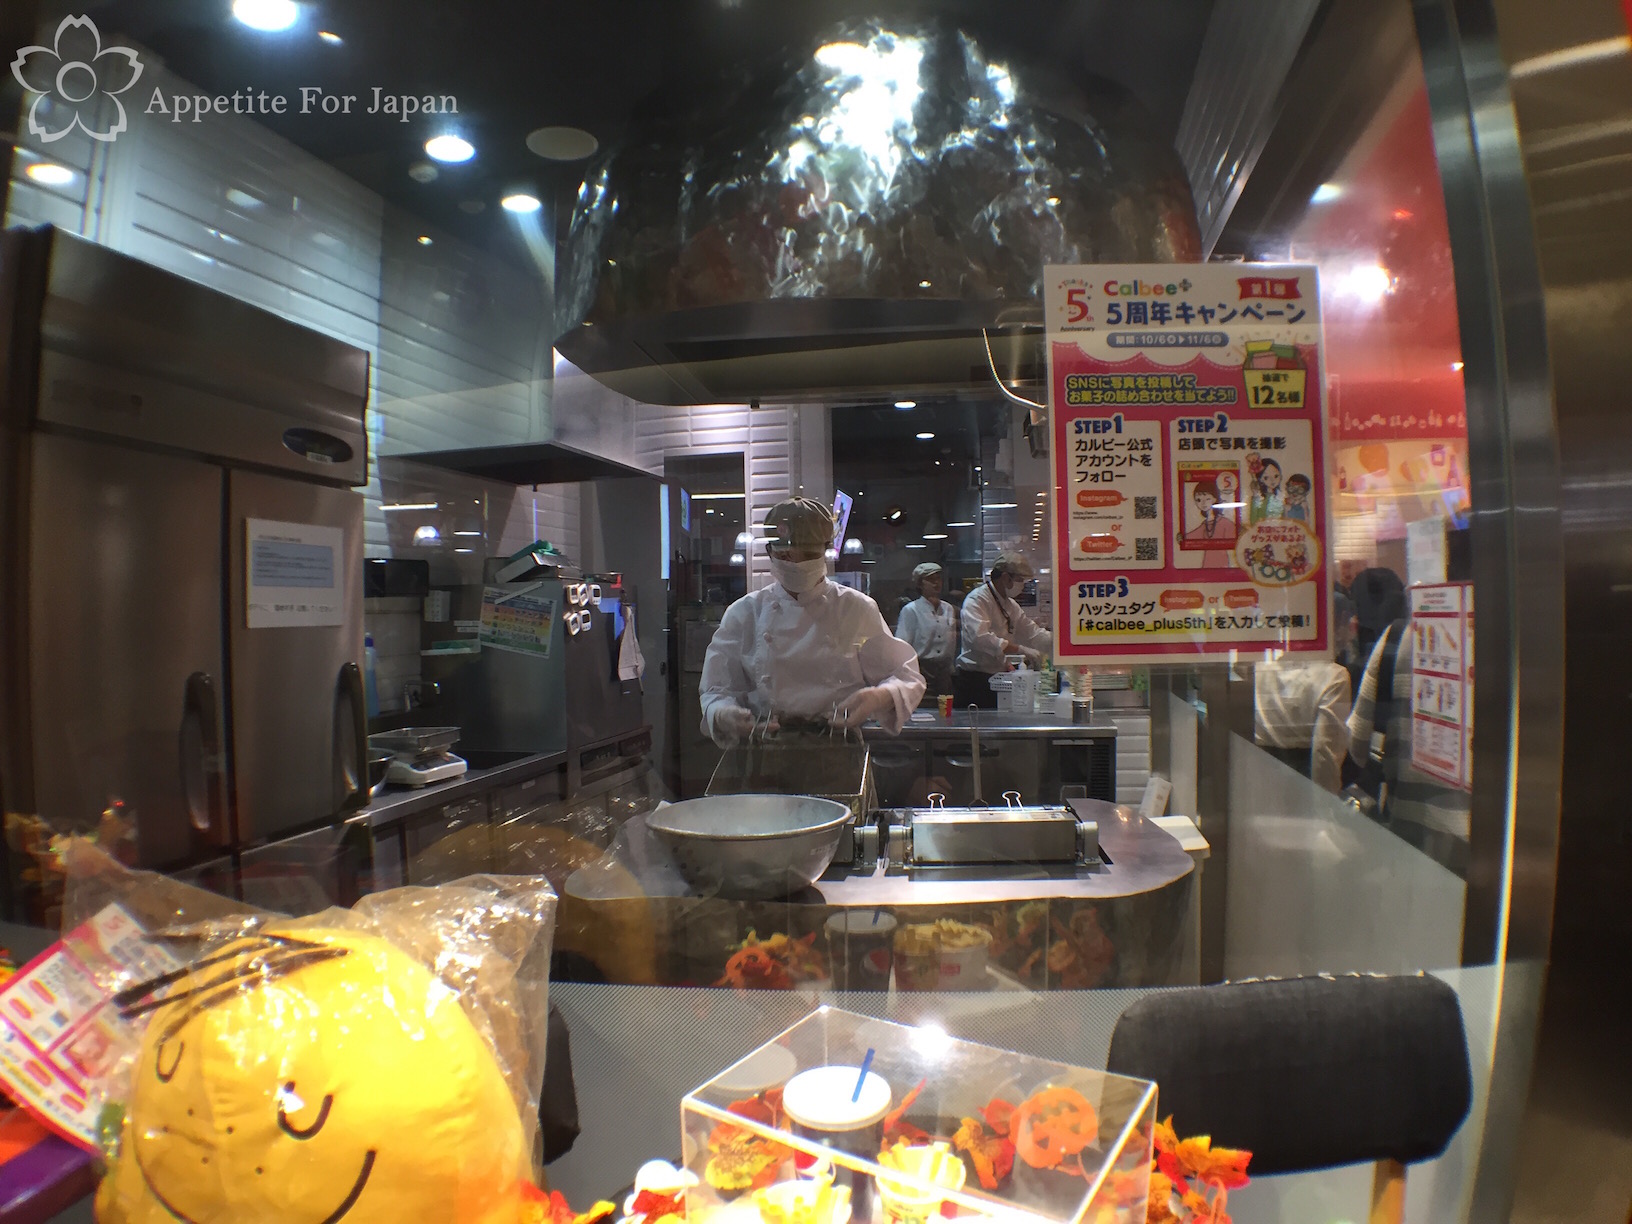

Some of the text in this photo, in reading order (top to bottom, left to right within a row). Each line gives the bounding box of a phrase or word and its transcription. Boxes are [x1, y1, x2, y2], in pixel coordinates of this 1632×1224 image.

[1106, 301, 1306, 326] 5周年キャンペーン
[1067, 376, 1195, 389] SNSに写真を投稿して
[1075, 438, 1153, 451] カルビー公式
[1178, 437, 1287, 450] 店頭で写真を撮影
[1075, 454, 1152, 467] アカウントを
[1076, 471, 1126, 483] フォロー
[1080, 494, 1118, 503] Instagram
[1087, 540, 1113, 548] Twitter
[1078, 601, 1155, 615] ハッシュタグ
